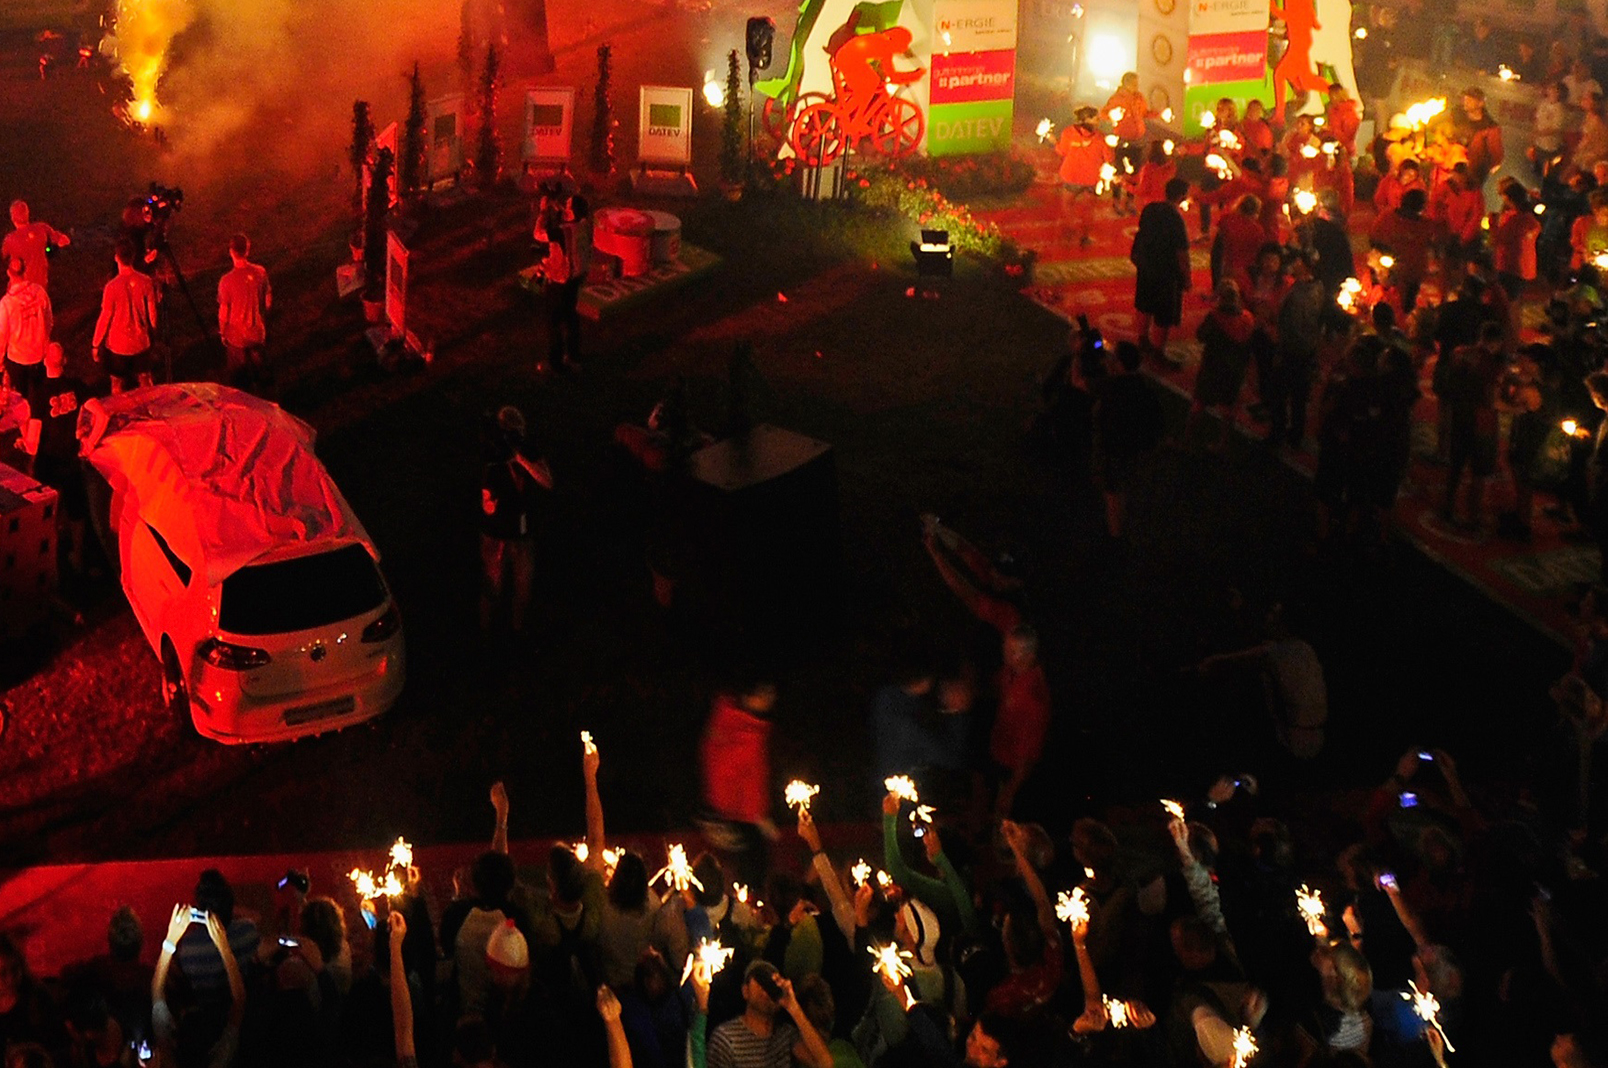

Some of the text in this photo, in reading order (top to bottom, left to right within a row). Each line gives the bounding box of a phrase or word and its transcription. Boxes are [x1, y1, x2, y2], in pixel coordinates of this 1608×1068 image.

[941, 17, 994, 30] N-ERGIE
[649, 127, 681, 137] DATEV
[936, 117, 1005, 141] DATEV
